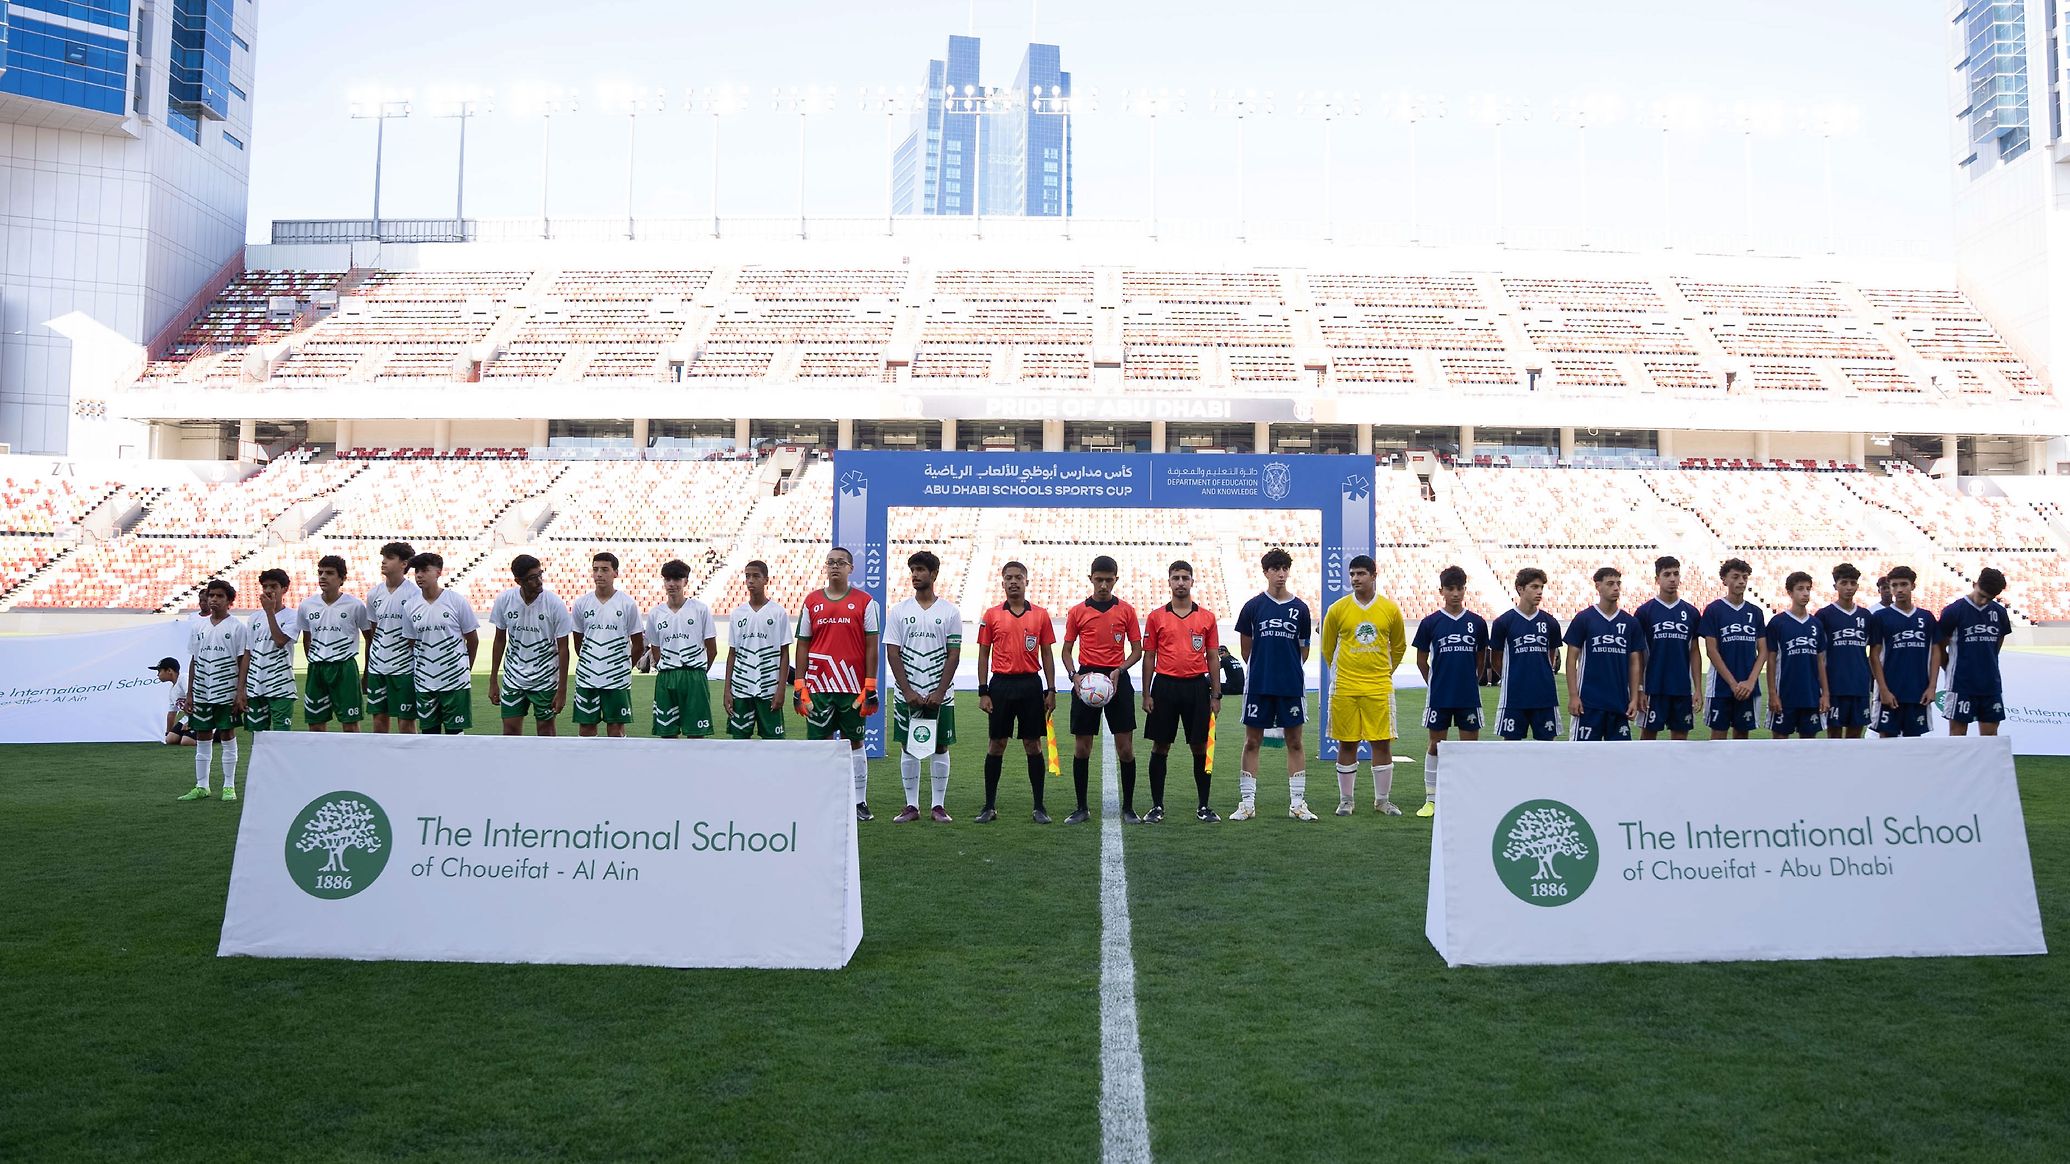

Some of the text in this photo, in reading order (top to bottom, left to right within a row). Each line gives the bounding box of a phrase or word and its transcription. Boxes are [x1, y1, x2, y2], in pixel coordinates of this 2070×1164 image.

[986, 398, 1231, 418] PRIDE OF ABU DHABI
[924, 463, 1133, 483] كأس مدارس أبوظبي للألعاب الرياضية
[1167, 467, 1205, 478] والمعرفة
[1206, 467, 1238, 477] التعليم
[1167, 478, 1210, 486] DEPARTMENT
[1221, 479, 1258, 487] EDUCATION
[924, 485, 1133, 496] ABU DHABI SCHOOLS SPORTS CUP
[1217, 488, 1258, 496] KNOWLEDGE
[373, 599, 382, 608] 07
[813, 603, 824, 613] 01
[308, 611, 320, 621] 08
[411, 614, 422, 623] 06
[507, 611, 519, 619] 05
[584, 609, 595, 619] 04
[1288, 607, 1299, 620] 12
[1681, 610, 1688, 621] 9
[1747, 612, 1753, 623] 7
[1988, 610, 1998, 622] 10
[657, 620, 669, 631] 03
[904, 616, 916, 625] 10
[1259, 618, 1298, 633] ISC
[1855, 616, 1865, 628] 14
[1918, 617, 1924, 628] 5
[1467, 622, 1474, 634] 8
[1536, 622, 1547, 633] 18
[1616, 622, 1627, 635] 17
[1652, 620, 1689, 634] ISC
[1720, 623, 1756, 637] ISC
[1811, 625, 1817, 636] 3
[1964, 624, 2000, 637] ISC
[1260, 630, 1274, 638] ABU
[1832, 628, 1866, 641] ISC
[1892, 630, 1926, 643] ISC
[1438, 634, 1475, 648] ISC
[1513, 634, 1548, 648] ISC
[1592, 634, 1627, 648] ISC
[1785, 636, 1818, 651] ISC
[1439, 645, 1453, 653] ABU
[1514, 646, 1528, 654] ABU
[9, 680, 113, 698] International
[116, 676, 162, 690] Schoo
[69, 695, 88, 703] Ain
[347, 707, 359, 716] 08
[400, 703, 412, 712] 07
[620, 708, 632, 716] 04
[1247, 703, 1259, 718] 12
[1829, 706, 1839, 720] 14
[1958, 700, 1971, 714] 10
[454, 715, 465, 724] 06
[1429, 710, 1438, 723] 8
[1648, 710, 1656, 723] 9
[1712, 709, 1719, 722] 7
[1775, 713, 1784, 724] 3
[1881, 710, 1890, 723] 5
[697, 719, 710, 728] 03
[855, 725, 865, 734] 01
[1503, 718, 1515, 732] 18
[1579, 726, 1592, 740] 17
[417, 815, 797, 853] The International School
[1618, 813, 1982, 851] The International School
[411, 856, 434, 877] of
[441, 857, 549, 880] Choueifat
[572, 859, 595, 881] Al
[602, 860, 639, 881] Ain
[1622, 860, 1644, 881] of
[1651, 858, 1756, 881] Choueifat
[1780, 857, 1822, 878] Abu
[1829, 855, 1894, 877] Dhabi
[315, 874, 353, 890] 1886
[1530, 882, 1568, 898] 1886
